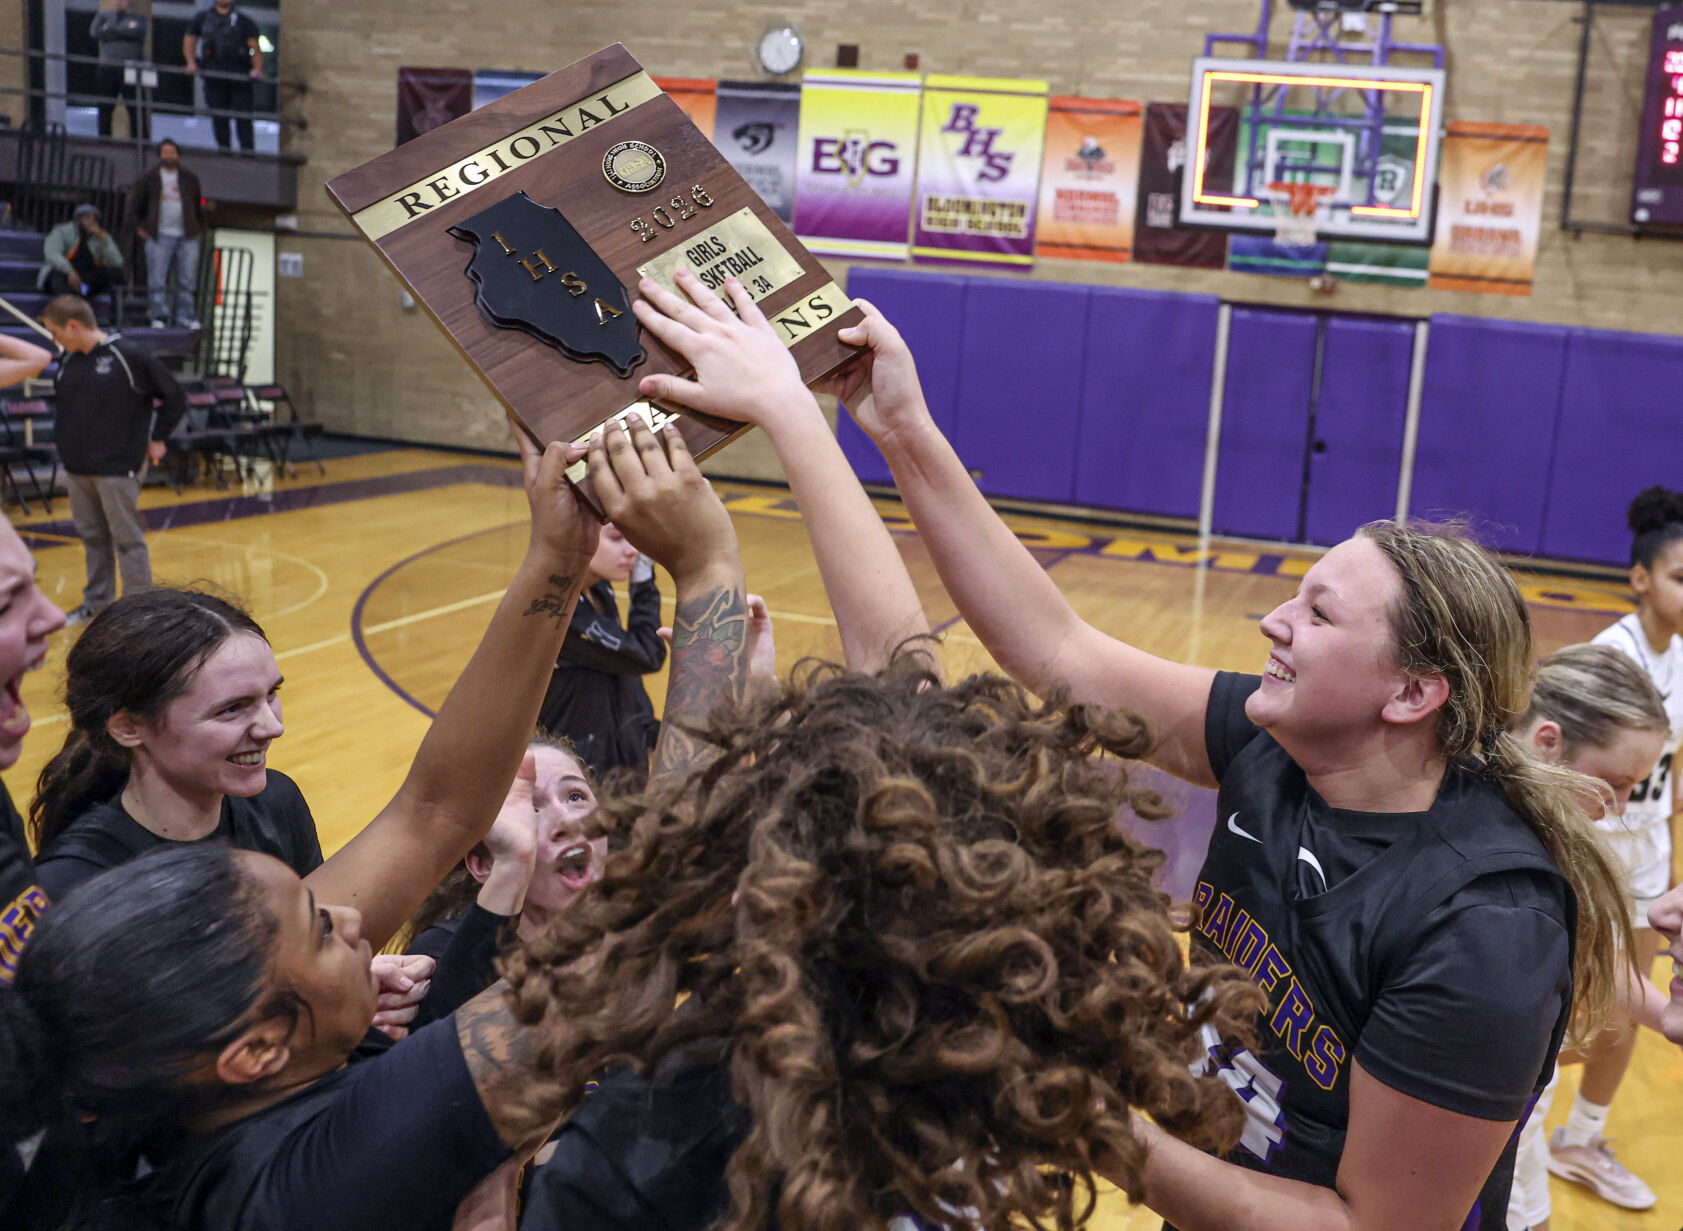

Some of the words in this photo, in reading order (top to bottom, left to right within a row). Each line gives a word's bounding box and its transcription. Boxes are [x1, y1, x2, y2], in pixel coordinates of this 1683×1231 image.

[393, 94, 631, 220] REGIONAL
[629, 142, 658, 158] SCHOOL
[941, 103, 1015, 182] BHS
[630, 184, 714, 242] 2026
[489, 231, 624, 326] IHSA
[685, 235, 728, 268] GIRLS
[699, 246, 764, 291] SKETBALL
[752, 275, 774, 294] 3A
[1199, 881, 1346, 1091] RAIDERS
